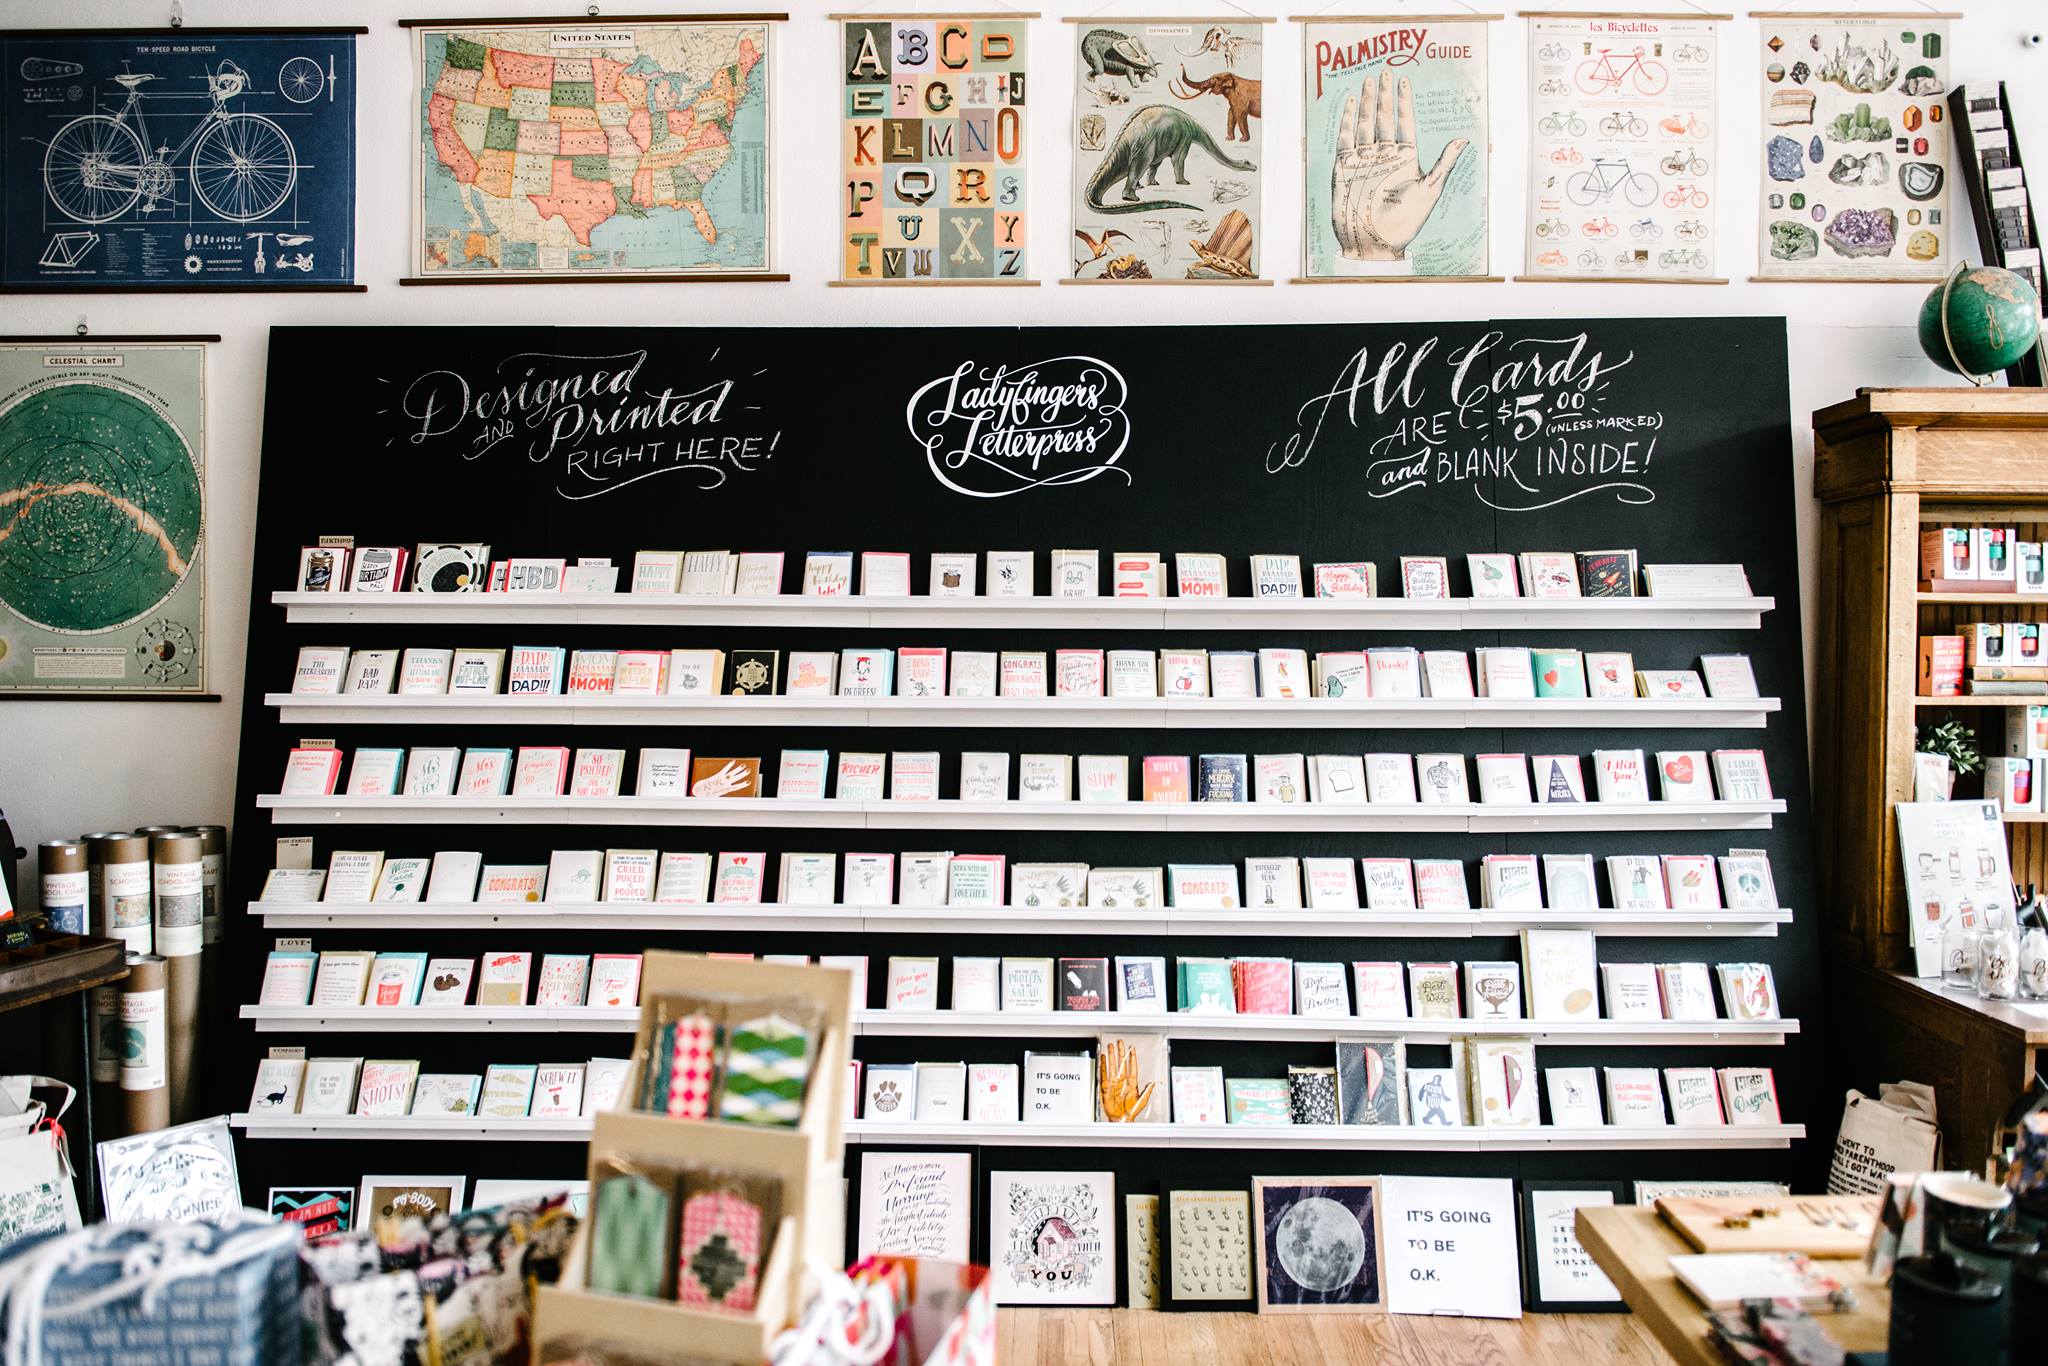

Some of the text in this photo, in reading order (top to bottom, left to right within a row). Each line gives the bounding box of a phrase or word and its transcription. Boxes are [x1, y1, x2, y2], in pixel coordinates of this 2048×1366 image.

[1590, 22, 1658, 33] les Bicyclettes
[553, 31, 632, 43] UNITED STATES
[847, 25, 1015, 80] A B C D
[1315, 29, 1472, 100] PALMISTRY GUIDE
[853, 75, 1023, 115] E F G H I J
[854, 108, 1021, 165] K L M N O
[848, 167, 1018, 217] P Q R S
[850, 215, 1019, 274] T U X Y
[885, 249, 1021, 276] V W Z
[403, 350, 647, 444] Designed
[927, 360, 1108, 430] Ladyfingers
[1266, 331, 1634, 473] All Cards
[472, 380, 734, 463] AND Printed
[945, 409, 1112, 471] Letterpress
[1370, 410, 1448, 455] ARE
[1596, 411, 1664, 431] MARKED)
[567, 431, 781, 481] RIGHT HERE!
[1367, 437, 1657, 492] and BLANK INSIDE!
[511, 566, 559, 589] HBD
[1260, 584, 1297, 595] DAD!!!
[1003, 660, 1042, 670] CONGRATS
[512, 680, 550, 692] DAD!!!
[841, 763, 881, 775] RICHER
[488, 879, 537, 891] CONGRATS!
[540, 1072, 563, 1086] SCREW
[1053, 1073, 1081, 1081] GOING
[1036, 1087, 1047, 1095] TO
[1036, 1102, 1051, 1110] O.K.
[1864, 1146, 1875, 1156] TO
[1845, 1150, 1895, 1173] PARENTHOOD
[1851, 1163, 1868, 1175] GOT
[316, 1202, 333, 1214] NOT
[409, 1193, 437, 1210] BODY
[1407, 1210, 1491, 1223] IT'S GOING
[1408, 1239, 1455, 1252] TO BE
[1031, 1270, 1072, 1280] YOU
[1410, 1269, 1440, 1281] O.K.
